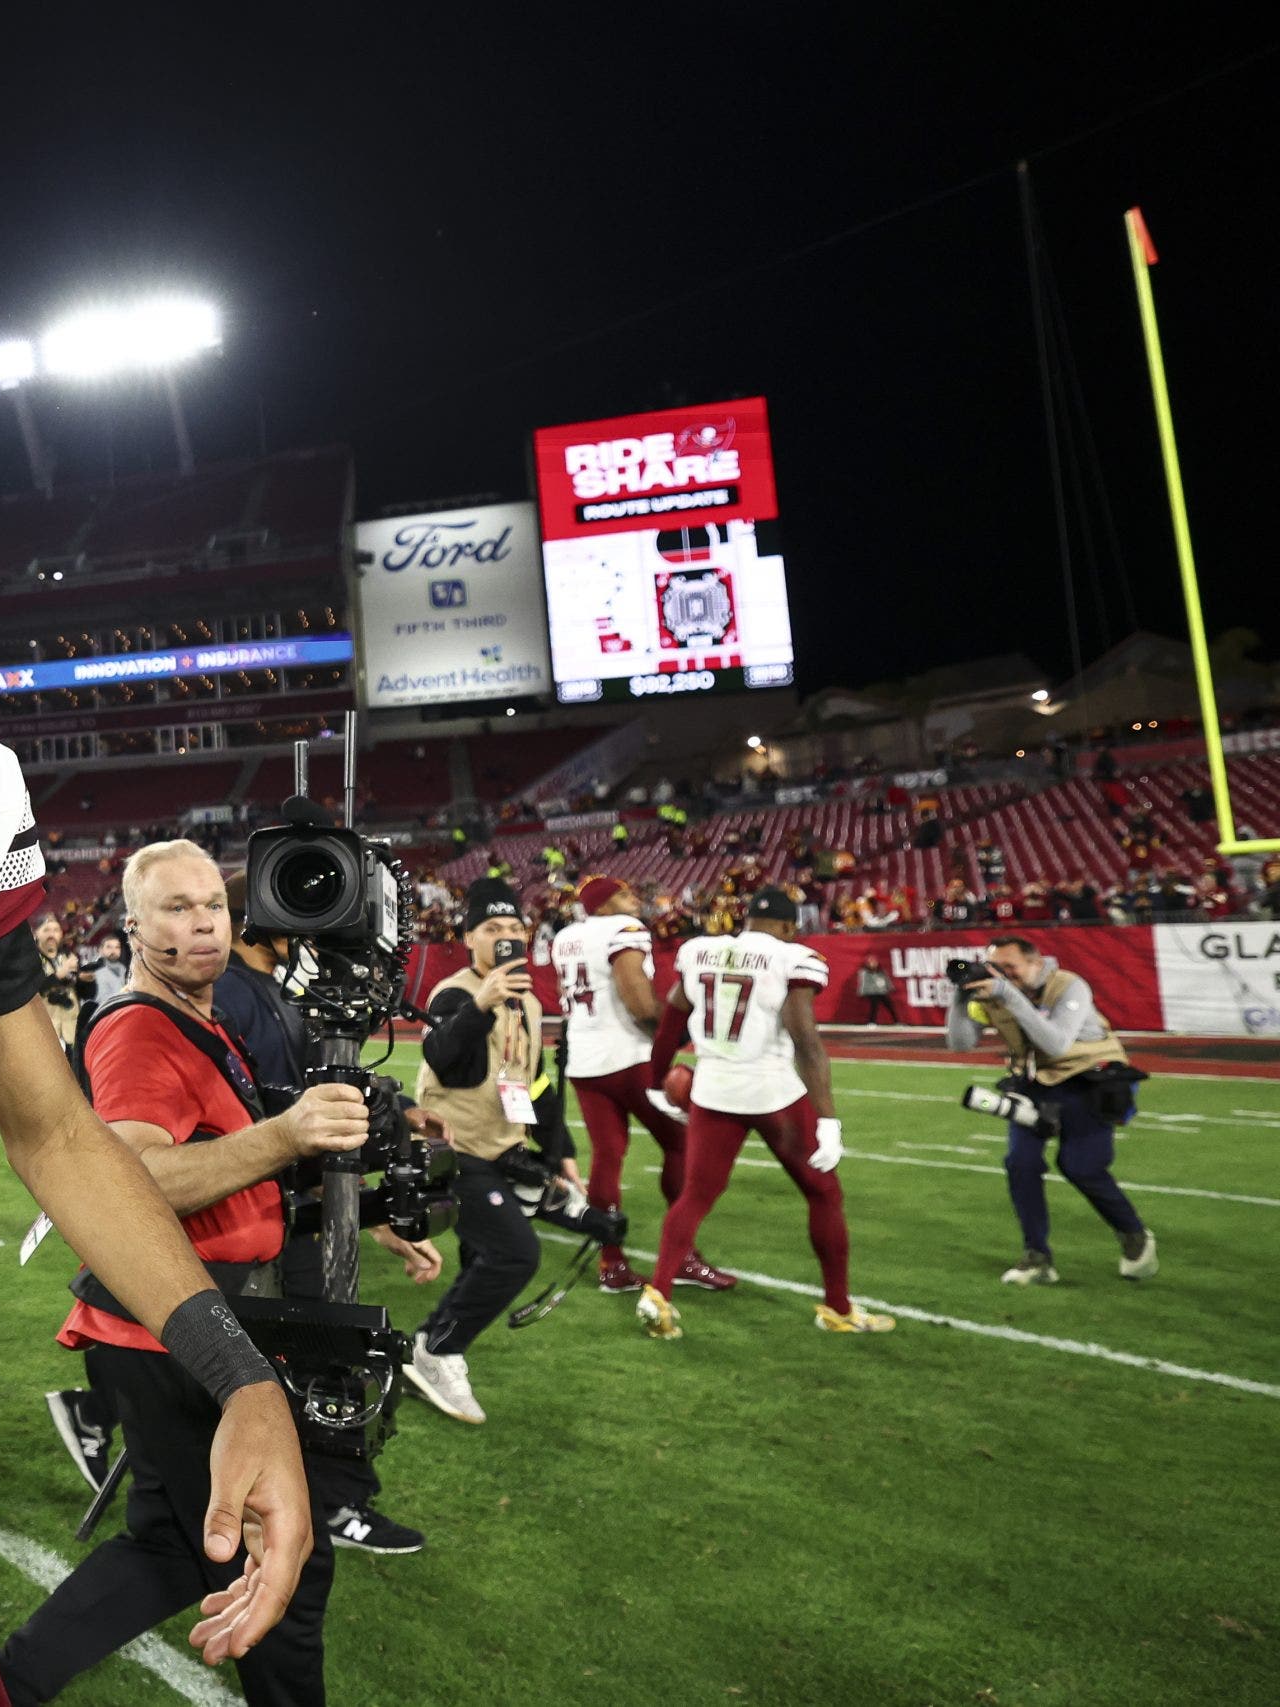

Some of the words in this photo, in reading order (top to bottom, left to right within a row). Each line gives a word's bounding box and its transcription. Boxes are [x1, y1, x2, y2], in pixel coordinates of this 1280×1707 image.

[565, 433, 676, 475] RIDE
[573, 450, 741, 498] SHARE
[383, 520, 513, 571] Ford
[74, 656, 176, 680] INNOVATION
[197, 645, 297, 669] INSURANCE
[699, 973, 753, 1041] 17
